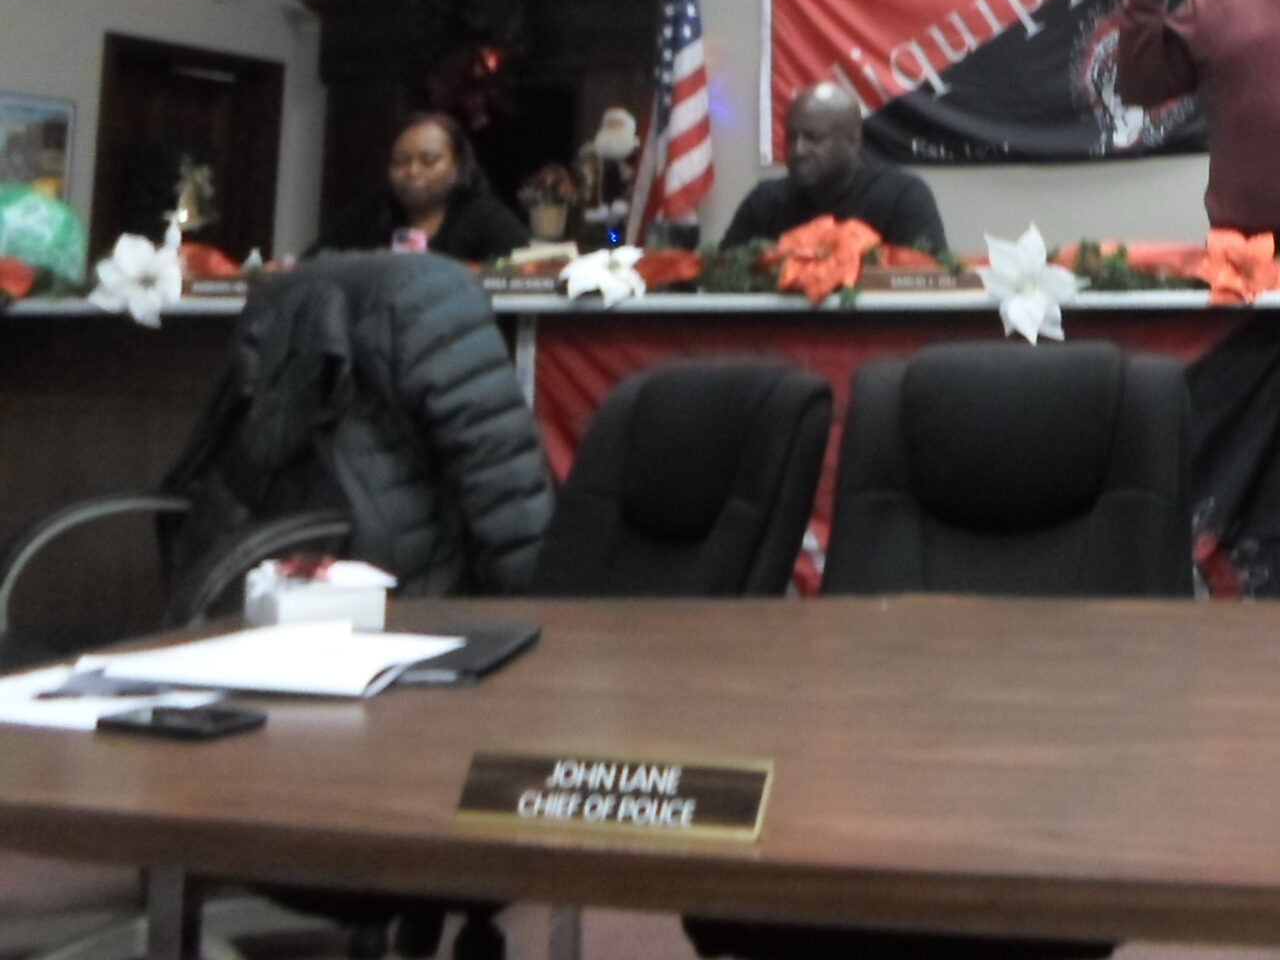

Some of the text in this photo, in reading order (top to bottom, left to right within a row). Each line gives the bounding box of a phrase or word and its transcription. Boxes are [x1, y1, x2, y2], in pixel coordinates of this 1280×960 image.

[546, 758, 682, 796] JOHN LANE
[516, 789, 697, 828] CHIEF OF POLICE
